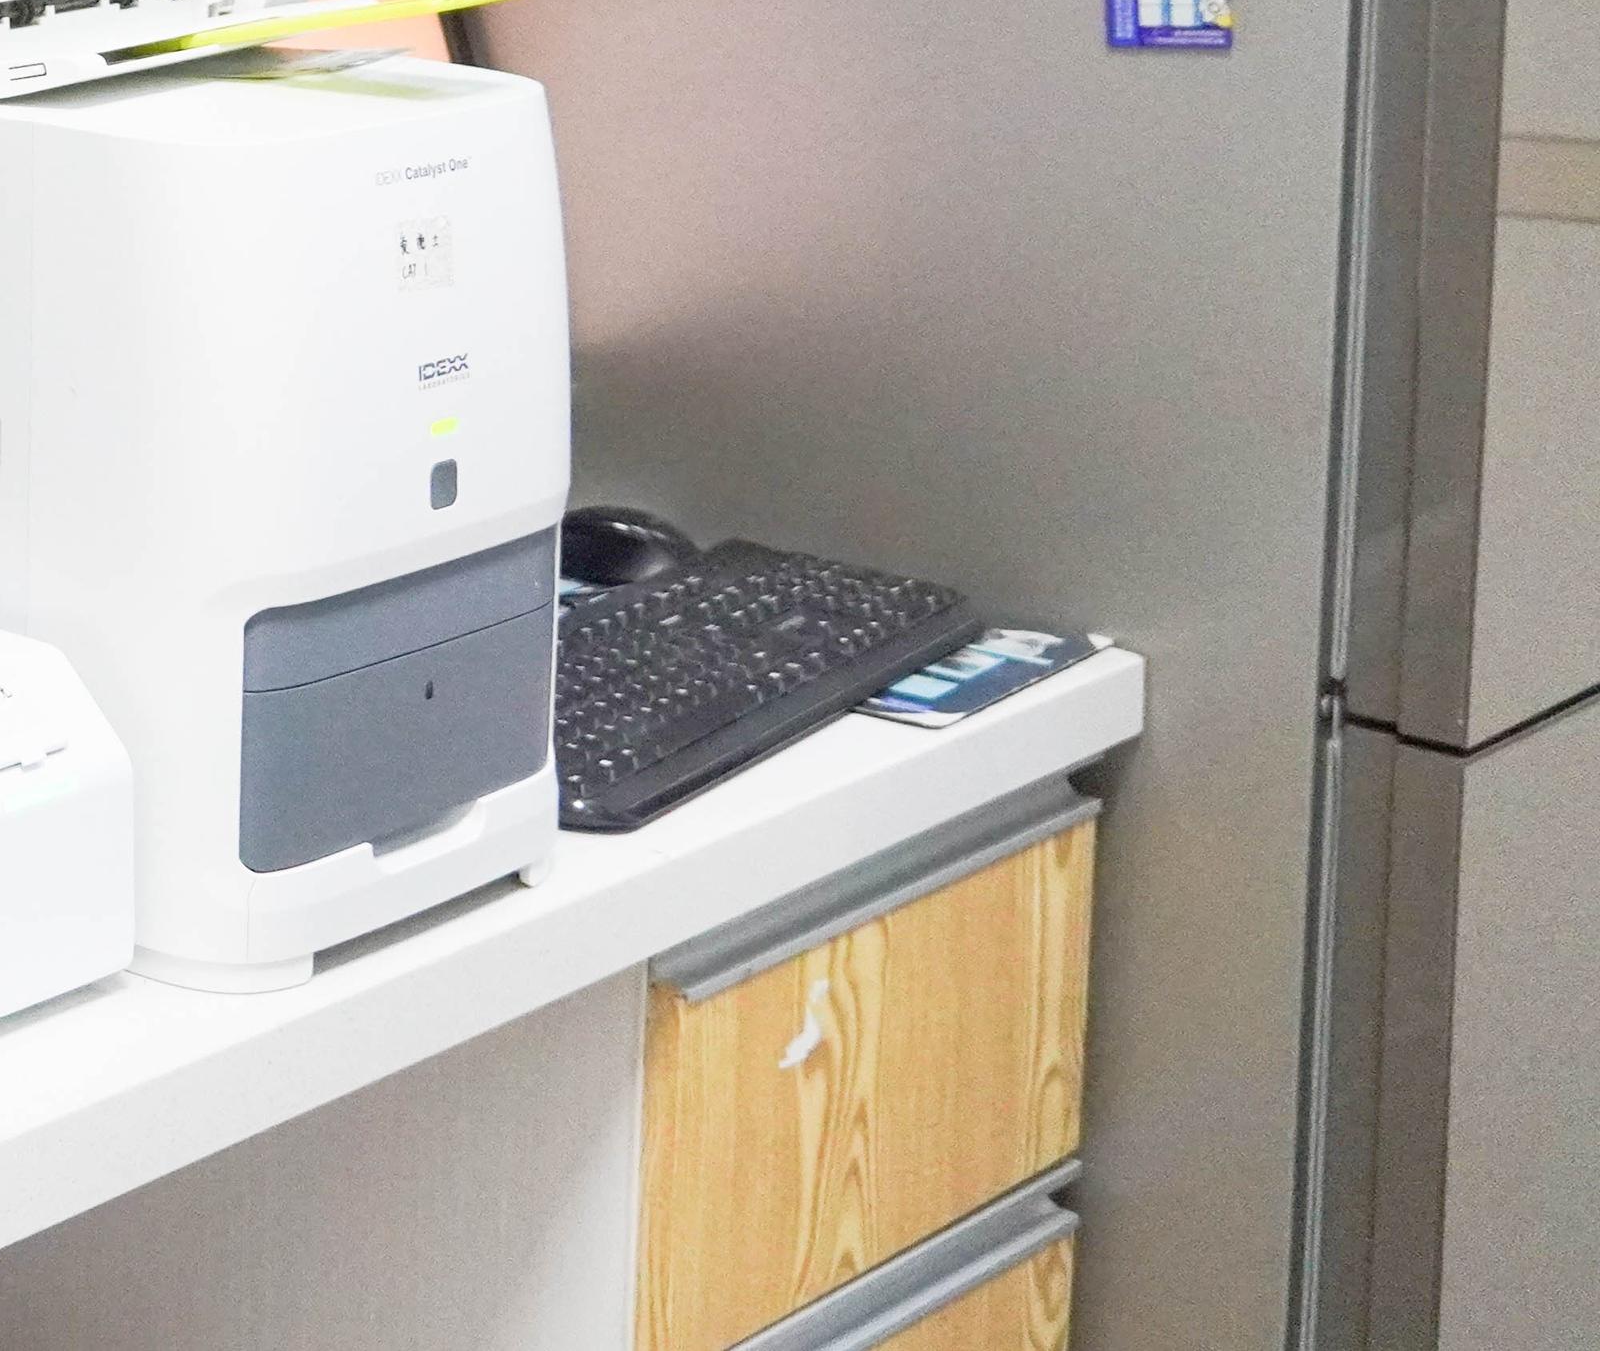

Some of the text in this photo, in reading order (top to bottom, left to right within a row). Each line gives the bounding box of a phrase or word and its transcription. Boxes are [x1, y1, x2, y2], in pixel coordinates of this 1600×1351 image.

[405, 162, 447, 180] Catalyst
[448, 157, 469, 171] One
[418, 353, 469, 382] IDEXX
